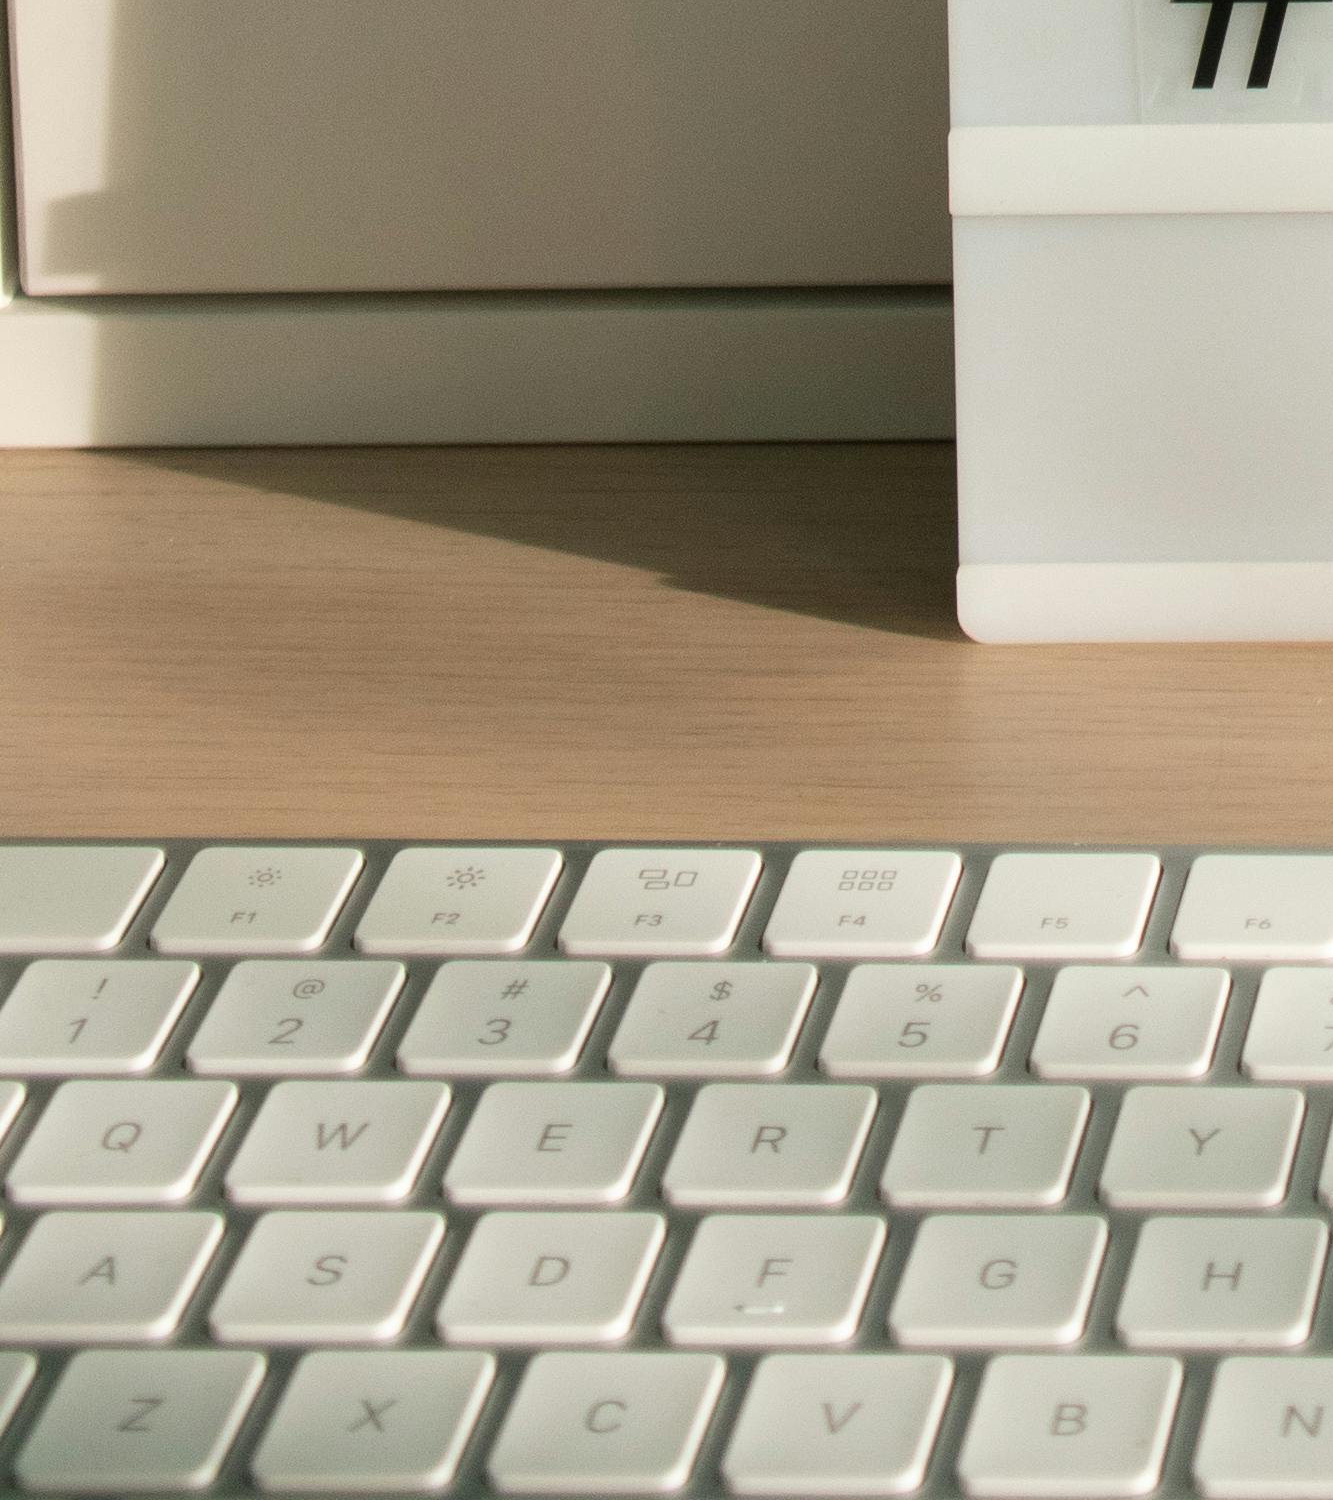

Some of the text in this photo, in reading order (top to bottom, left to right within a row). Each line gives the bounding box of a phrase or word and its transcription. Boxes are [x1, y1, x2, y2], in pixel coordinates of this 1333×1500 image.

[69, 1017, 89, 1044] 1
[268, 1016, 305, 1045] 2
[477, 1017, 513, 1046] 3
[687, 1019, 720, 1046] 4
[897, 1021, 930, 1049] 5
[1107, 1023, 1140, 1051] 6
[100, 1121, 144, 1154] Q
[316, 1122, 370, 1151] W
[536, 1122, 573, 1153] E
[750, 1124, 788, 1154] R
[974, 1125, 1004, 1155] T
[1189, 1128, 1221, 1156] Y
